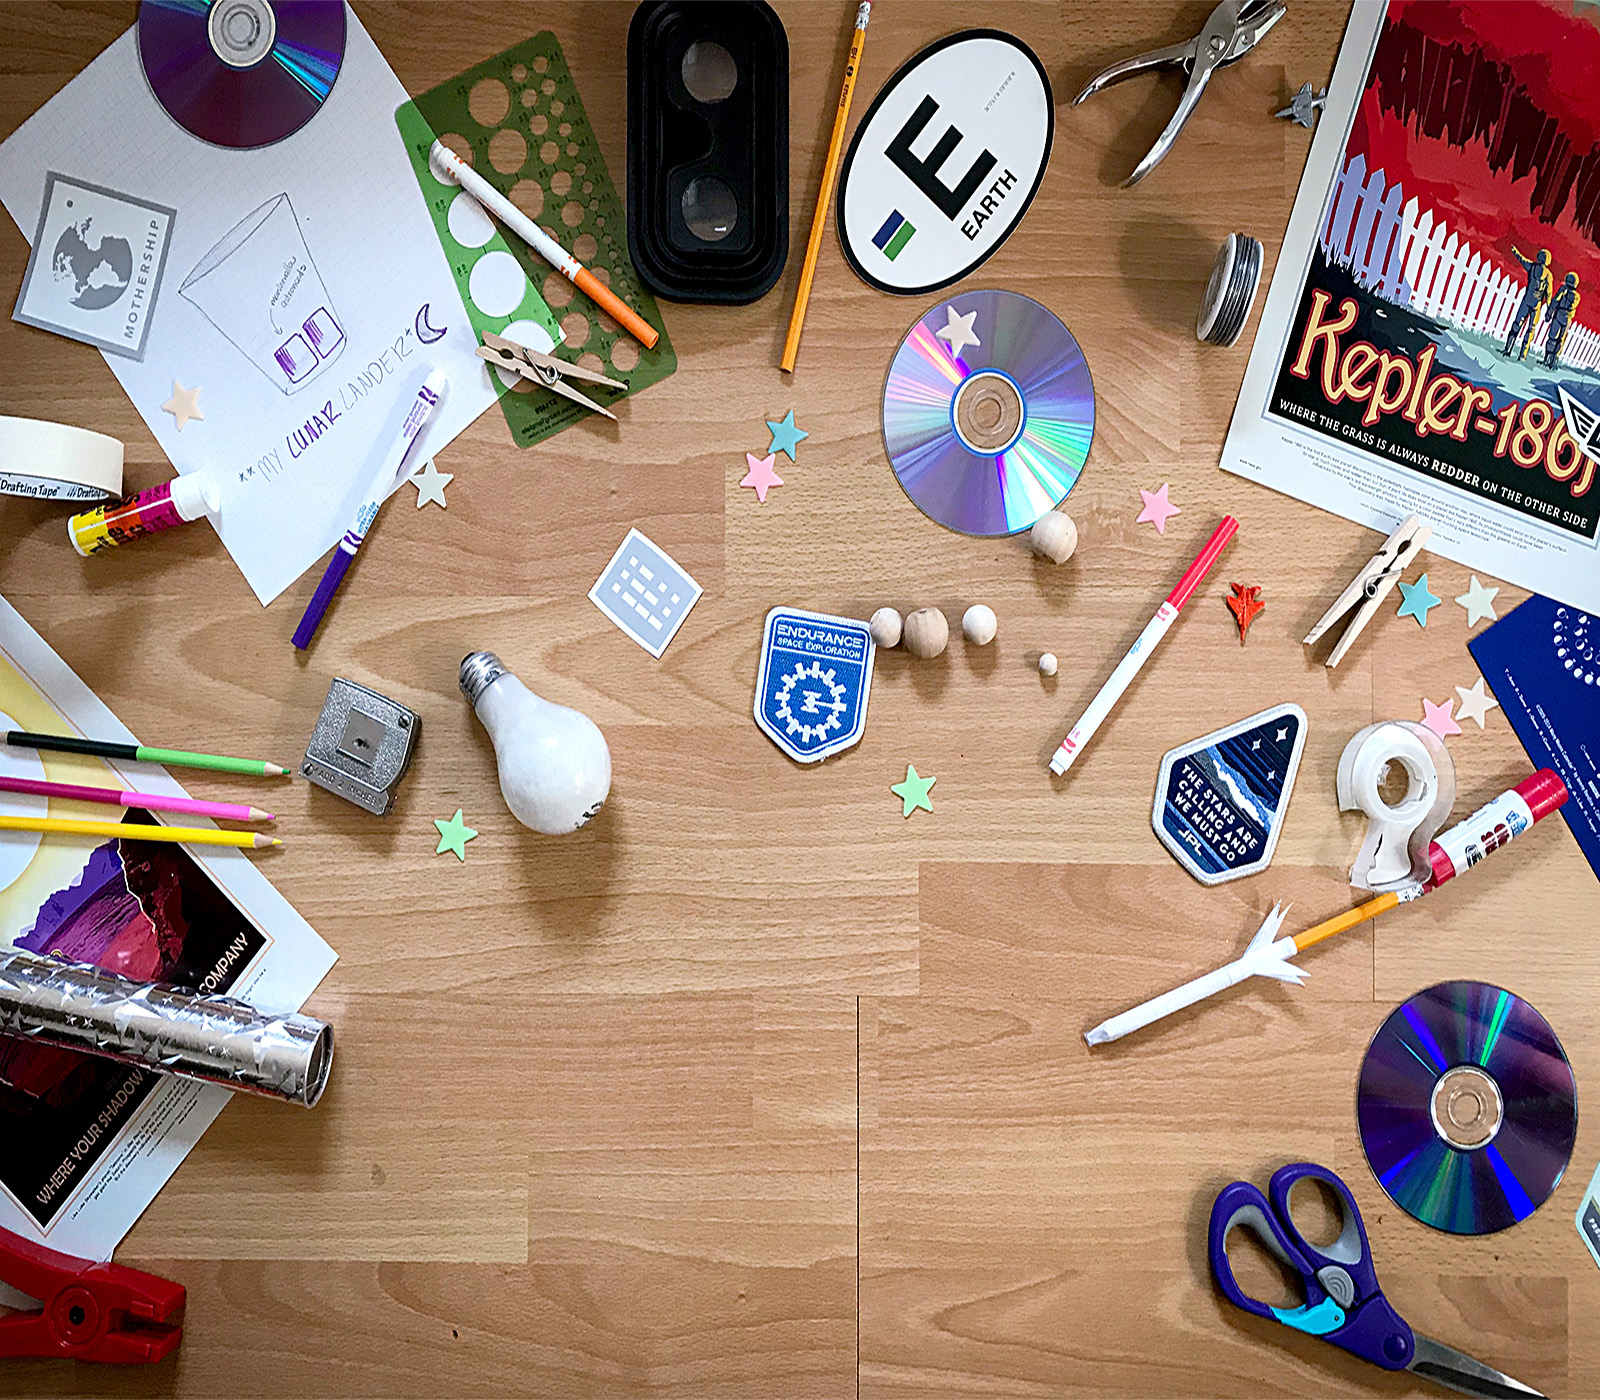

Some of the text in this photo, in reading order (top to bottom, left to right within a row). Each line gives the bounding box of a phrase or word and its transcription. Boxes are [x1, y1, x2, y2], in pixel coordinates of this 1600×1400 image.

[884, 94, 998, 222] E
[960, 169, 1018, 241] EARTH
[124, 219, 160, 340] MOTHERSHIP
[257, 448, 284, 482] MY
[286, 400, 342, 459] LUNAR
[1280, 399, 1588, 530] WHERE THE GRASS IS ALWAYS REDDER ON THE OTHER SIDE
[1, 478, 38, 496] Drafting
[777, 637, 860, 659] SPACE EXPLORATION
[778, 624, 864, 648] ENDURANCE
[316, 768, 378, 806] ADD 2 INCHES
[1178, 780, 1246, 856] CALLING AND
[1181, 764, 1258, 850] THE STARS ARE
[1174, 792, 1236, 862] WE MUST GO
[1178, 829, 1202, 856] JPL
[200, 932, 250, 994] COMPANY
[36, 1070, 144, 1205] WHERE YOUR SHADOW
